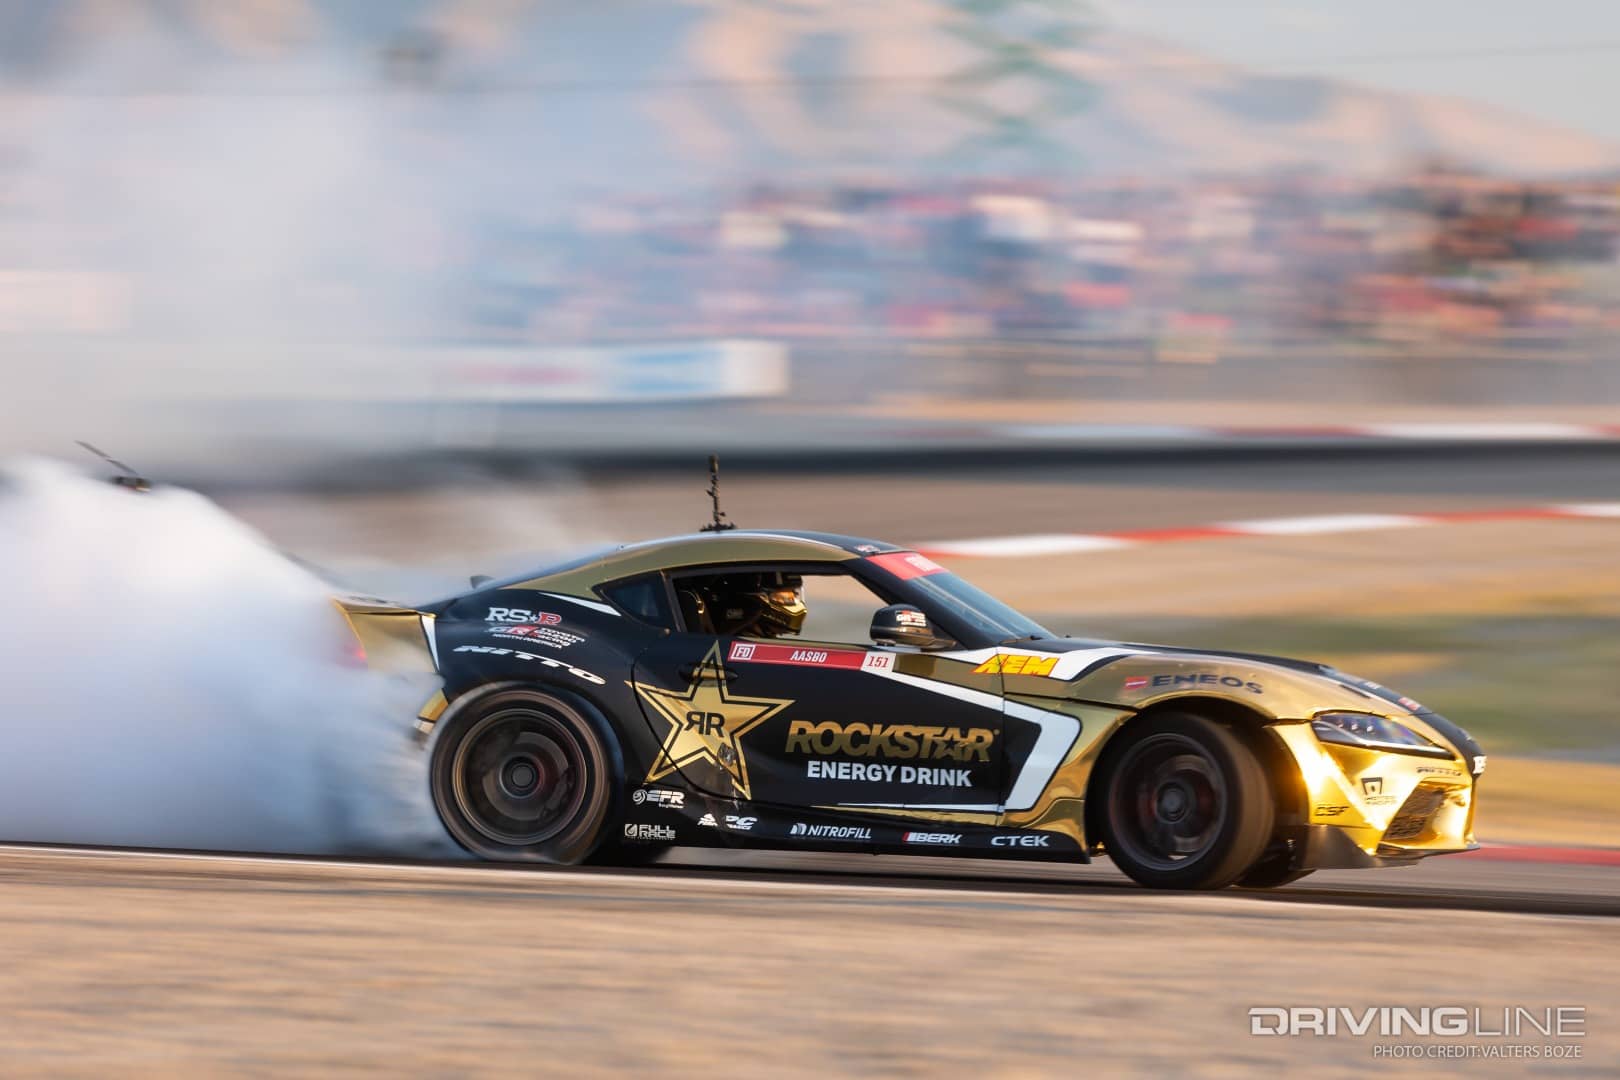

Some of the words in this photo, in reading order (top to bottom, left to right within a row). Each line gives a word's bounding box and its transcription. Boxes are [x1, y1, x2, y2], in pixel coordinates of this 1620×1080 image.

[453, 645, 606, 685] NITTO
[790, 650, 828, 663] AASBO
[866, 656, 889, 668] 151
[973, 654, 1060, 676] AEM
[1152, 674, 1264, 694] ENEOS
[807, 760, 898, 783] ENERGY
[900, 765, 972, 787] DRINK
[808, 825, 872, 839] NITROFILL
[916, 832, 963, 844] BERK
[990, 835, 1050, 847] CTEK
